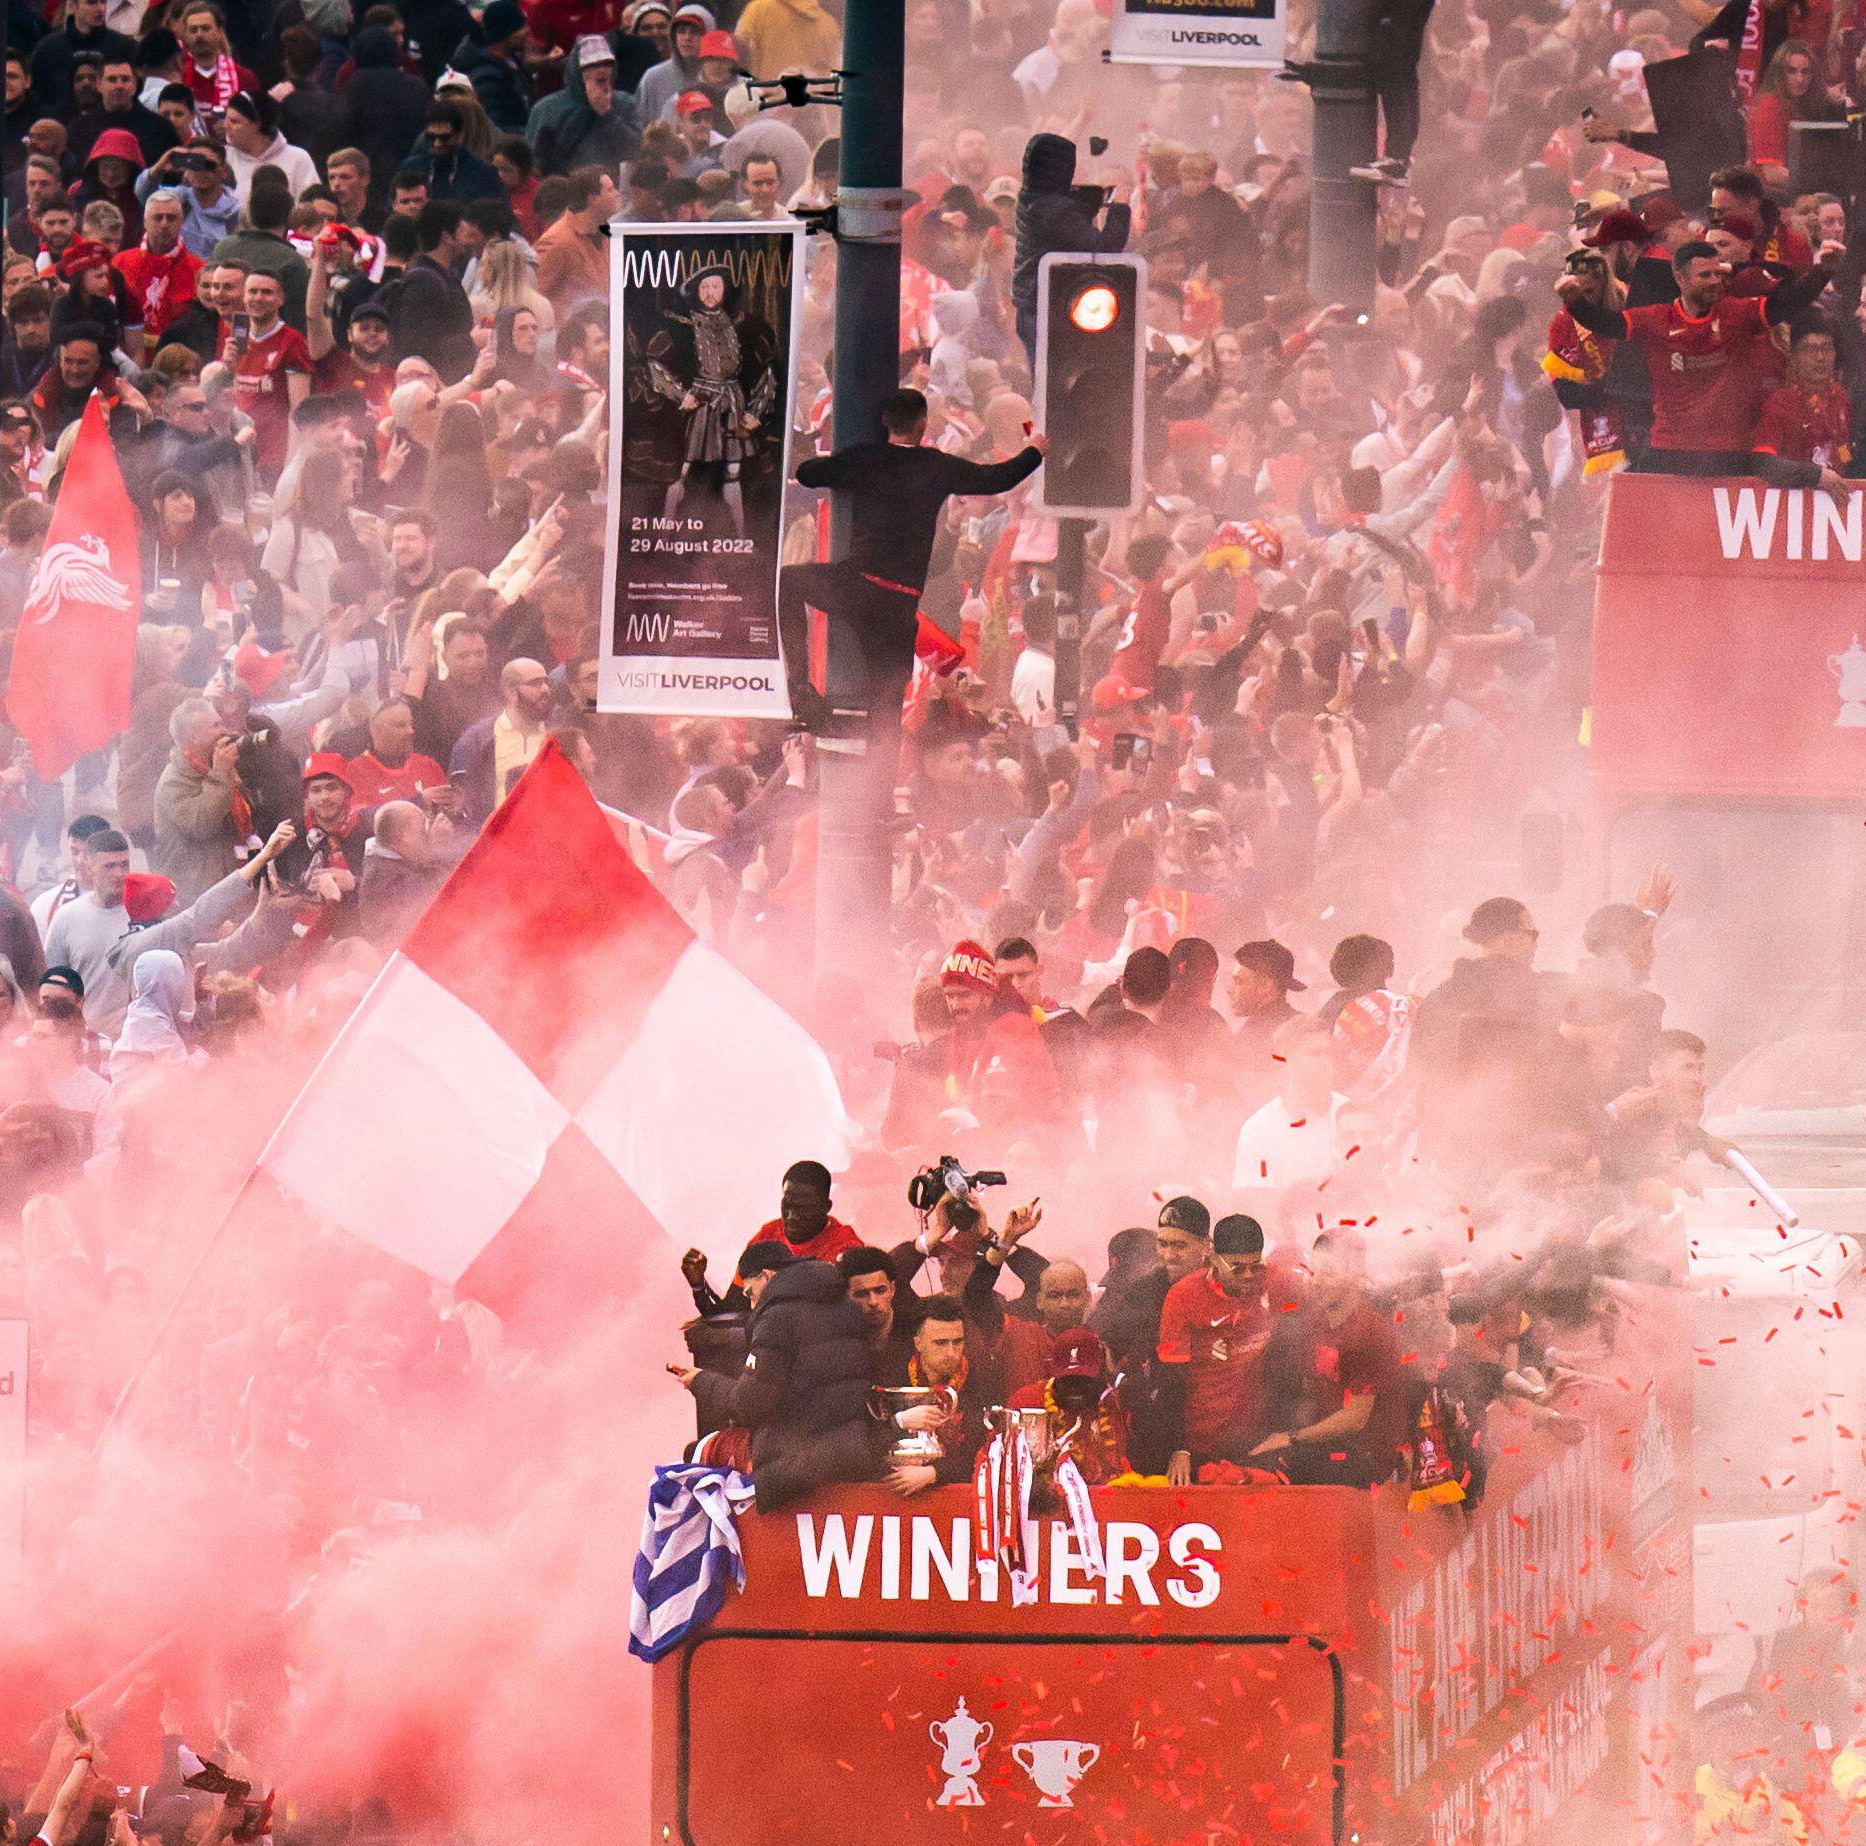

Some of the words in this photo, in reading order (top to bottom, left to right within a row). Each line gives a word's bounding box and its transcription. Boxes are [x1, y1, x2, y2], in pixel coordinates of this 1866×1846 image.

[631, 516, 648, 530] 21
[653, 517, 682, 533] May
[687, 518, 703, 530] to
[630, 539, 650, 553] 29
[654, 539, 708, 555] August
[712, 540, 754, 554] 2022
[617, 671, 775, 692] VISITLIVERPOOL
[796, 1512, 1221, 1608] WINNERS
